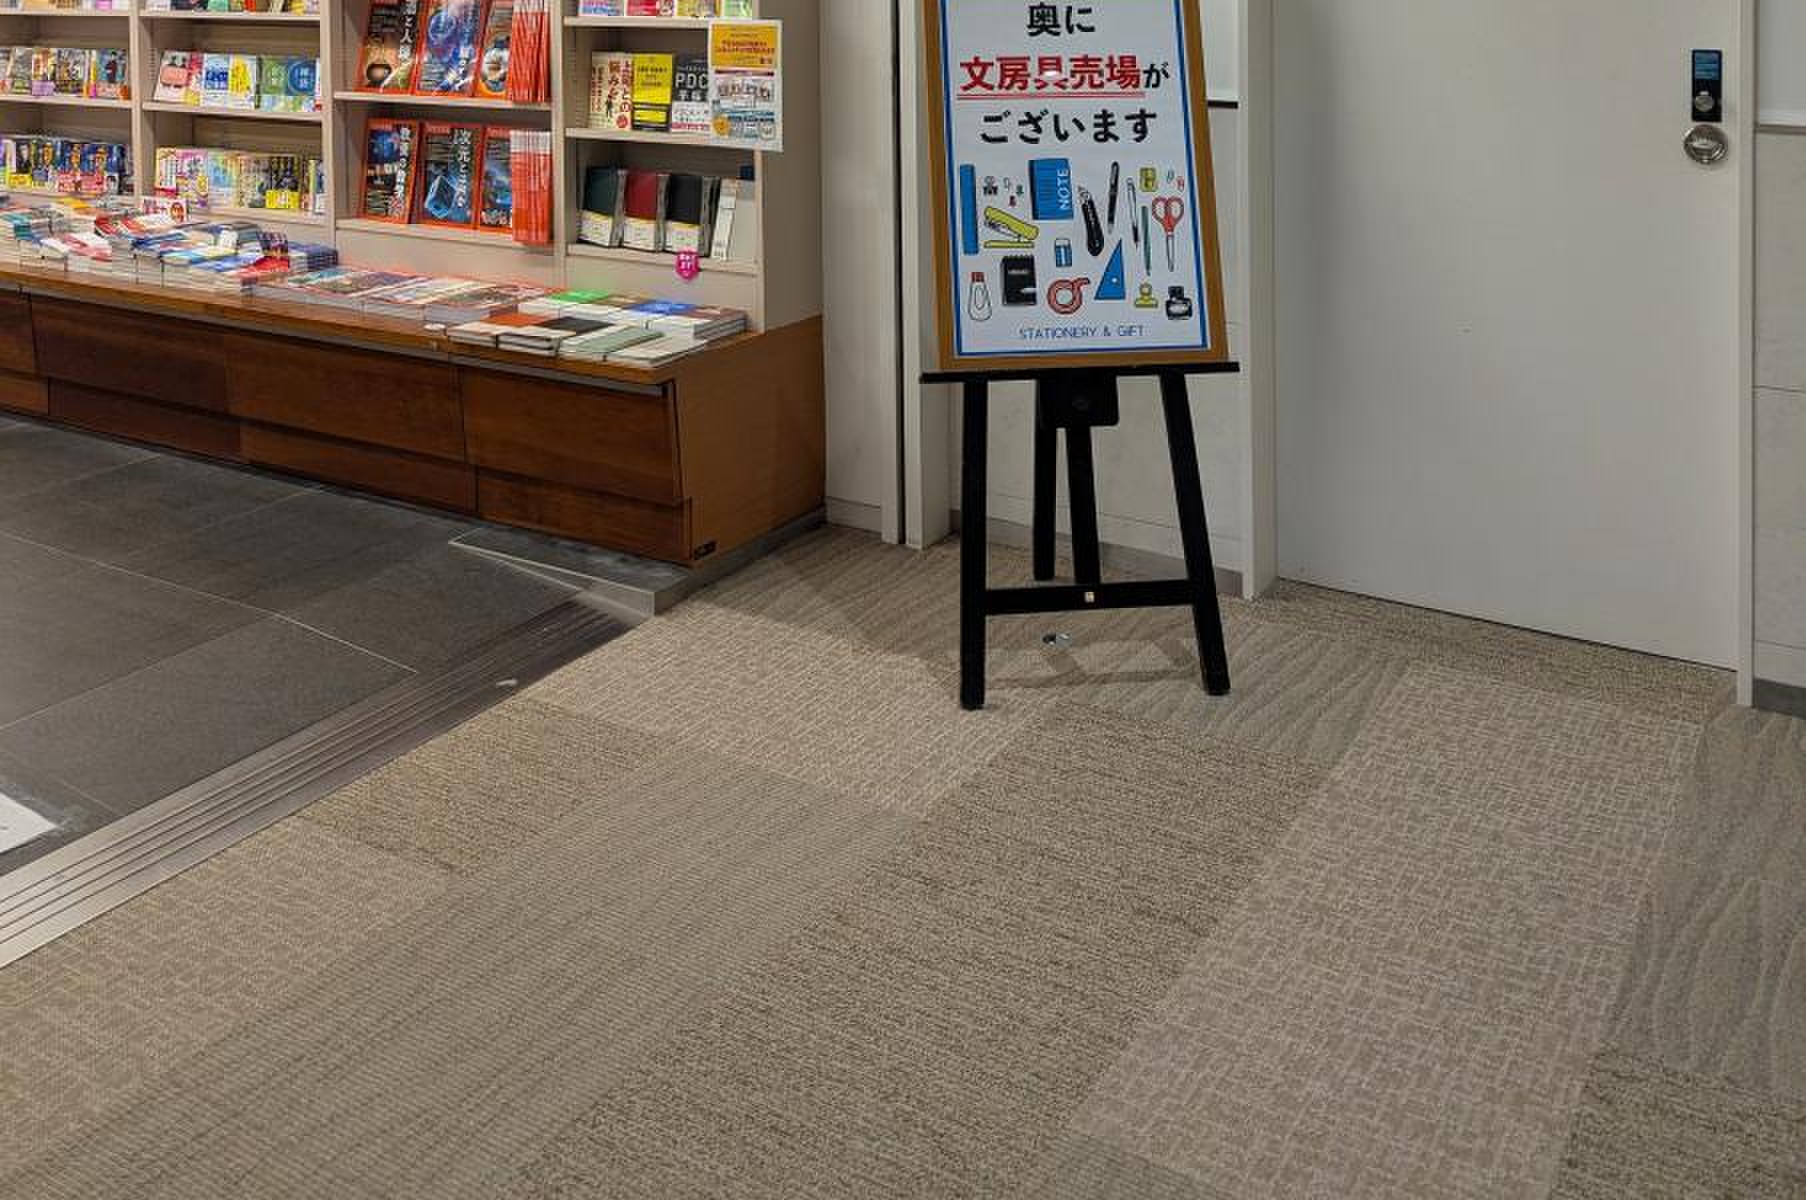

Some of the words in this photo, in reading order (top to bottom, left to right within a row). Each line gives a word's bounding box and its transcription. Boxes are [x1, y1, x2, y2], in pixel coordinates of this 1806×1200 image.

[1026, 1, 1097, 37] 奥に
[960, 54, 1169, 92] 文房具売場が
[980, 108, 1157, 144] ございます
[1057, 168, 1071, 211] NOTE
[1019, 326, 1097, 340] STATIONERY
[1104, 326, 1111, 337] &
[1119, 325, 1144, 337] GIFT
